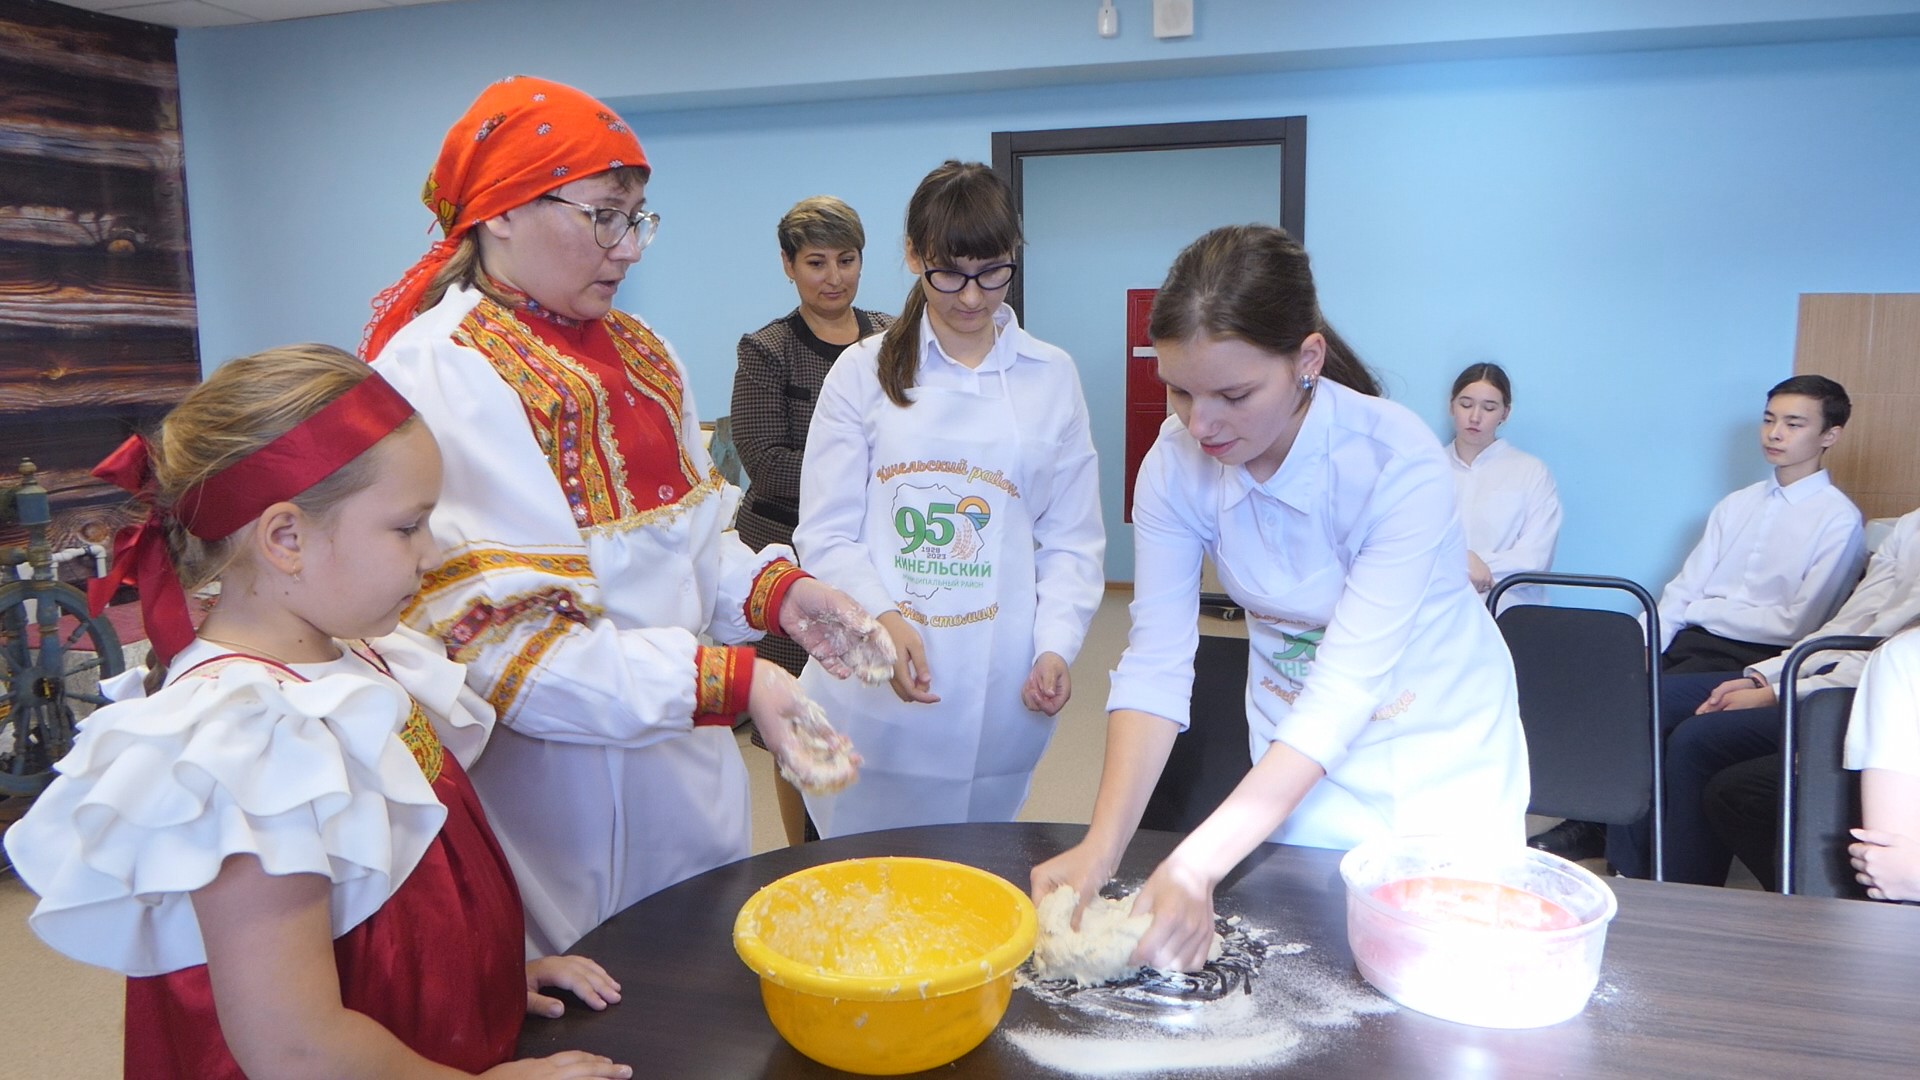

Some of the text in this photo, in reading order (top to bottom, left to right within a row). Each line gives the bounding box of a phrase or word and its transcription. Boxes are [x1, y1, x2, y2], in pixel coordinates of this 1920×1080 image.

[895, 502, 956, 555] 95
[921, 546, 941, 554] 1928
[926, 552, 947, 560] 2023
[894, 555, 992, 578] КИНЕЛЬСКИЙ
[960, 580, 984, 589] РАЙОН
